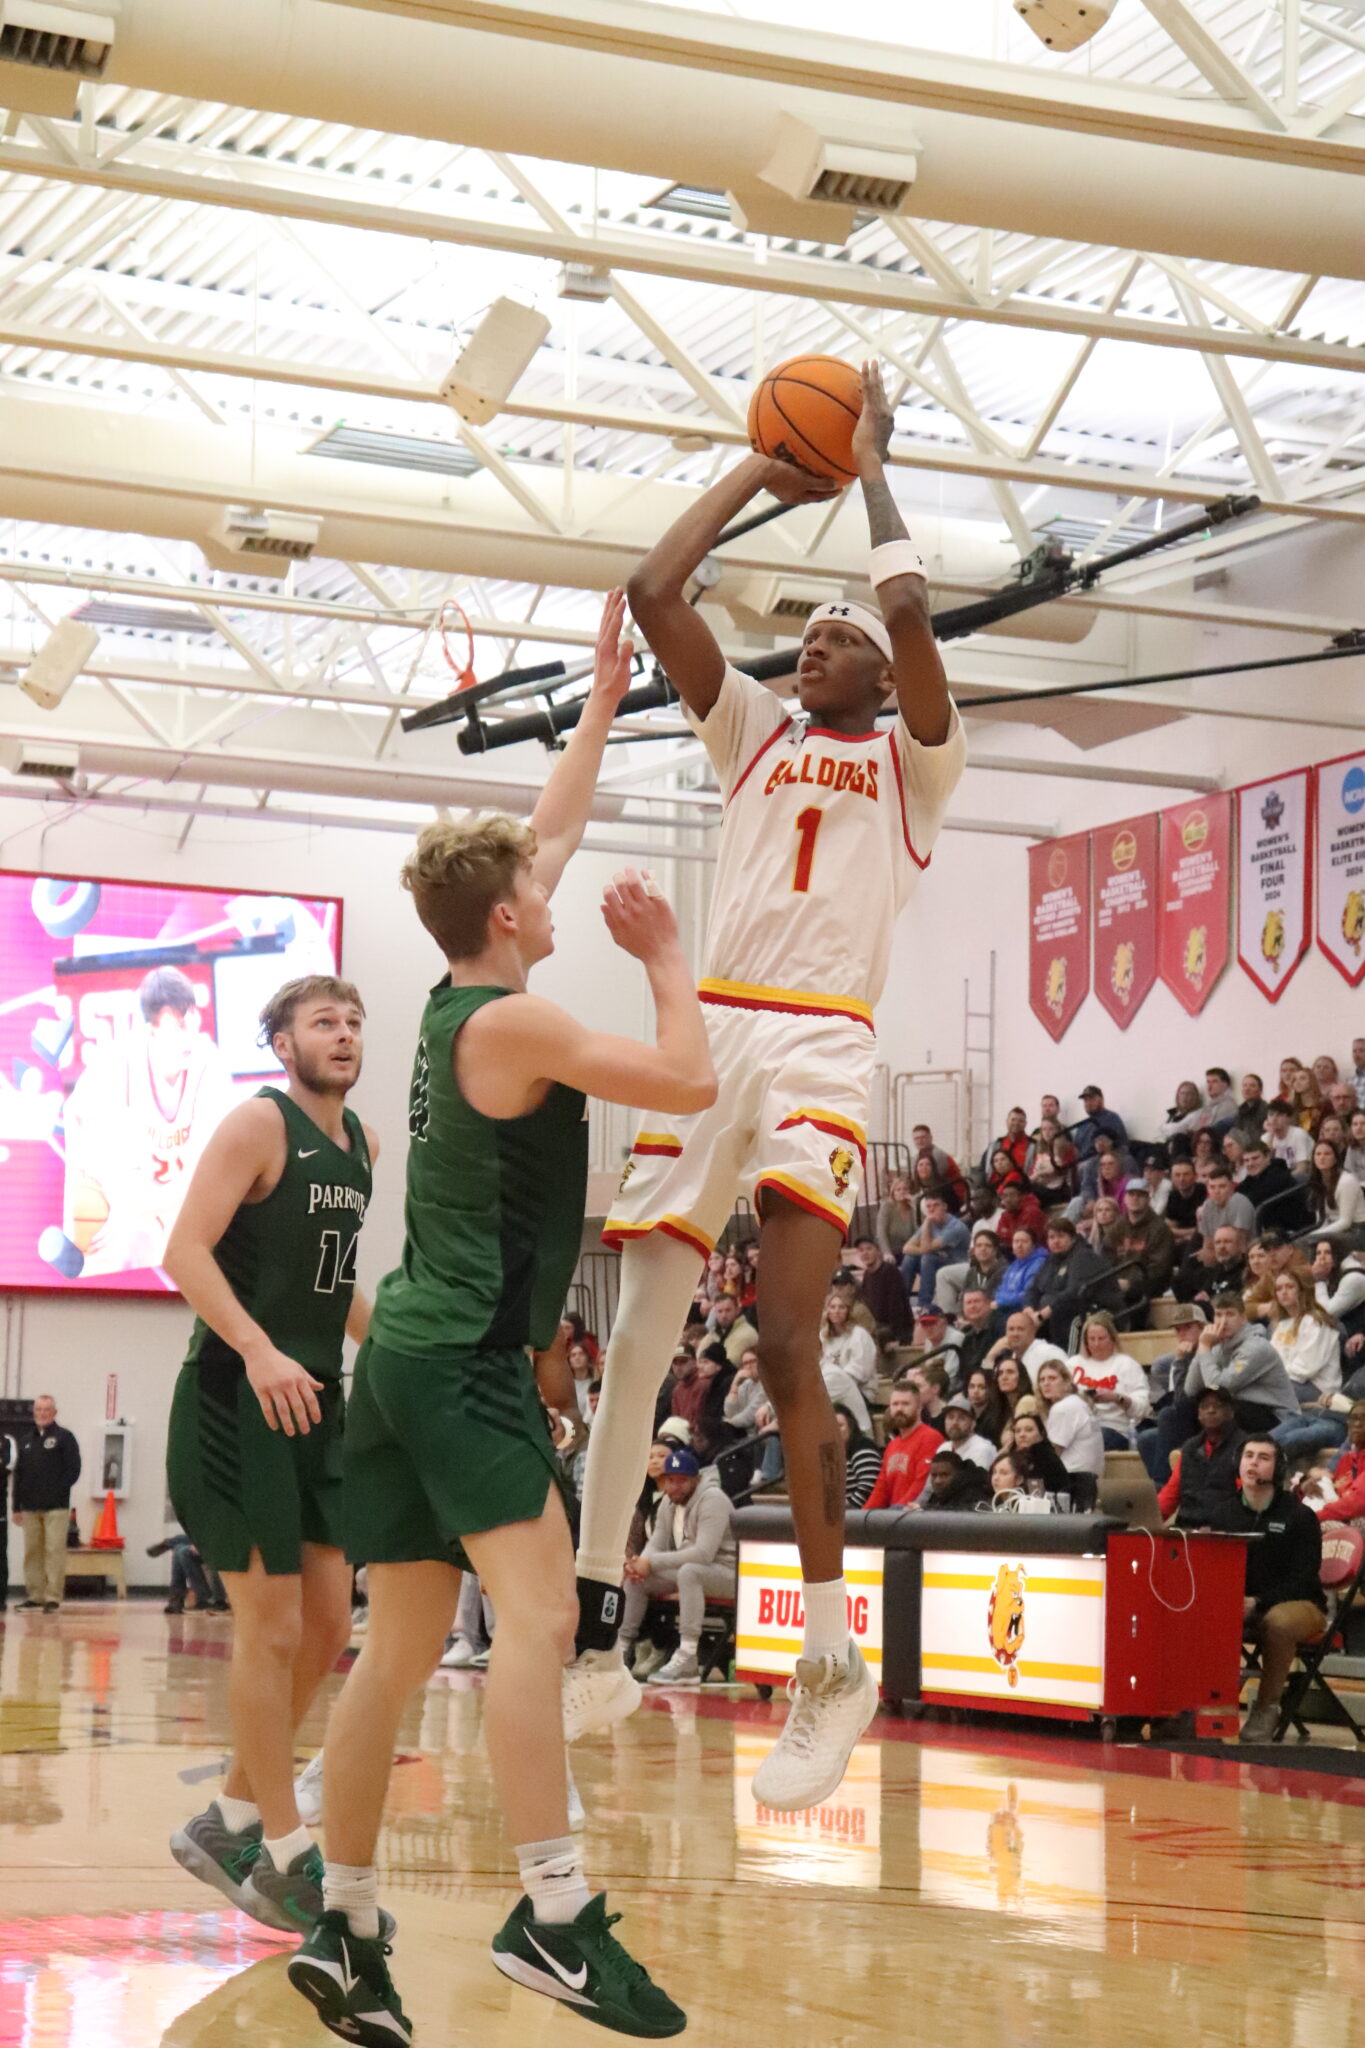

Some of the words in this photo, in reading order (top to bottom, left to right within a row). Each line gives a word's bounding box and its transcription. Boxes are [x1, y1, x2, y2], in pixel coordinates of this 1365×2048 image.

[764, 753, 878, 801] BLLDOGS
[1337, 822, 1365, 837] WOMEN
[792, 805, 825, 893] 1
[1330, 836, 1365, 853] BASKETB
[1250, 844, 1297, 864] BASKETBALL
[1331, 853, 1353, 867] ELITE
[1259, 859, 1285, 875] FINAL
[1260, 873, 1285, 890] FOUR
[758, 1588, 869, 1636] BULG
